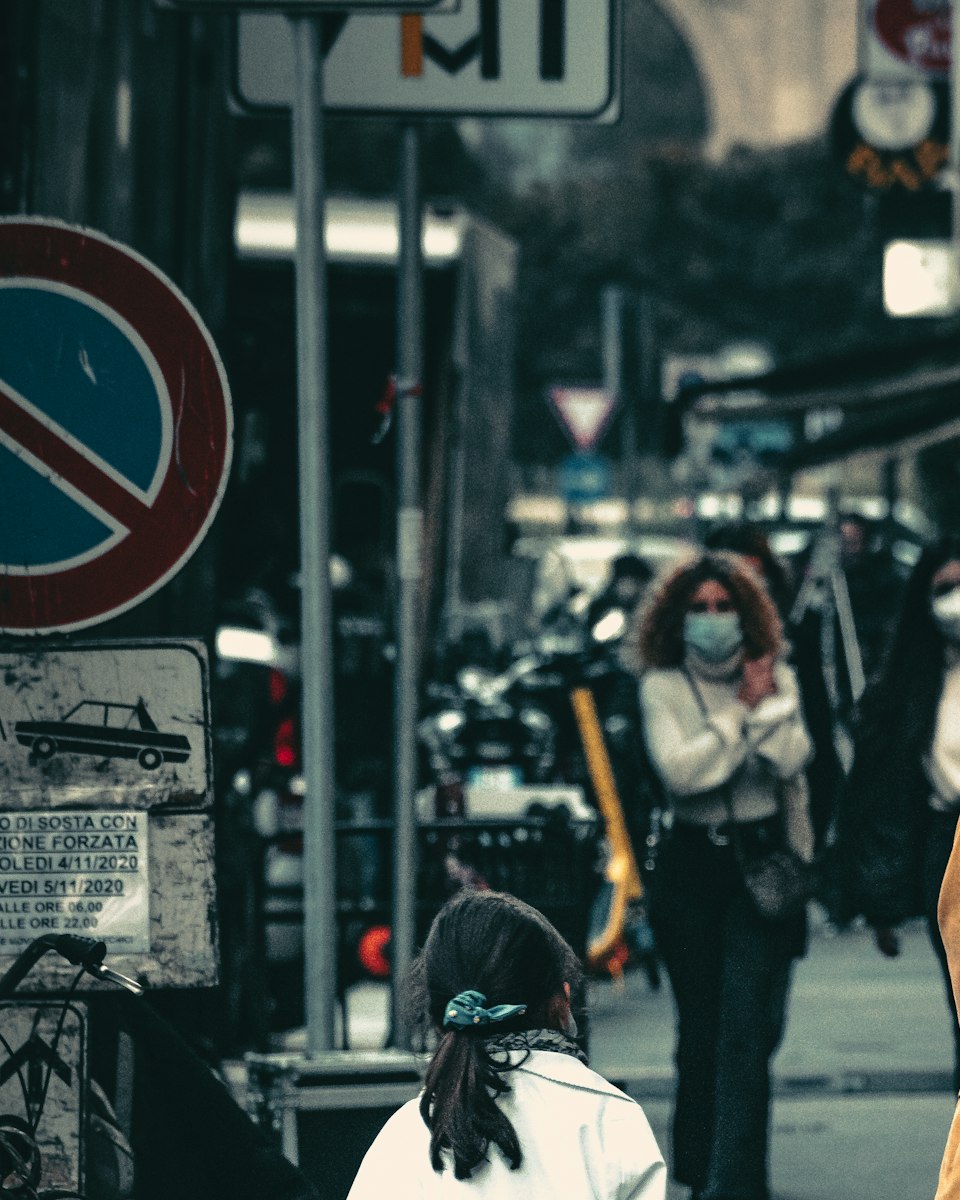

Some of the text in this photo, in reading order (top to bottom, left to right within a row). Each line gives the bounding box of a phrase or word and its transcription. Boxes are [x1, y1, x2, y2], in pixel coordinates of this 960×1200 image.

[16, 817, 32, 830] DI
[38, 816, 94, 829] SOSTA
[100, 816, 137, 829] CON
[53, 835, 138, 850] FORZATA
[58, 856, 138, 870] 4/11/2020
[44, 879, 123, 893] 5/11/2020
[35, 902, 64, 913] ORE
[69, 902, 103, 912] 06.00
[30, 918, 59, 929] ORE
